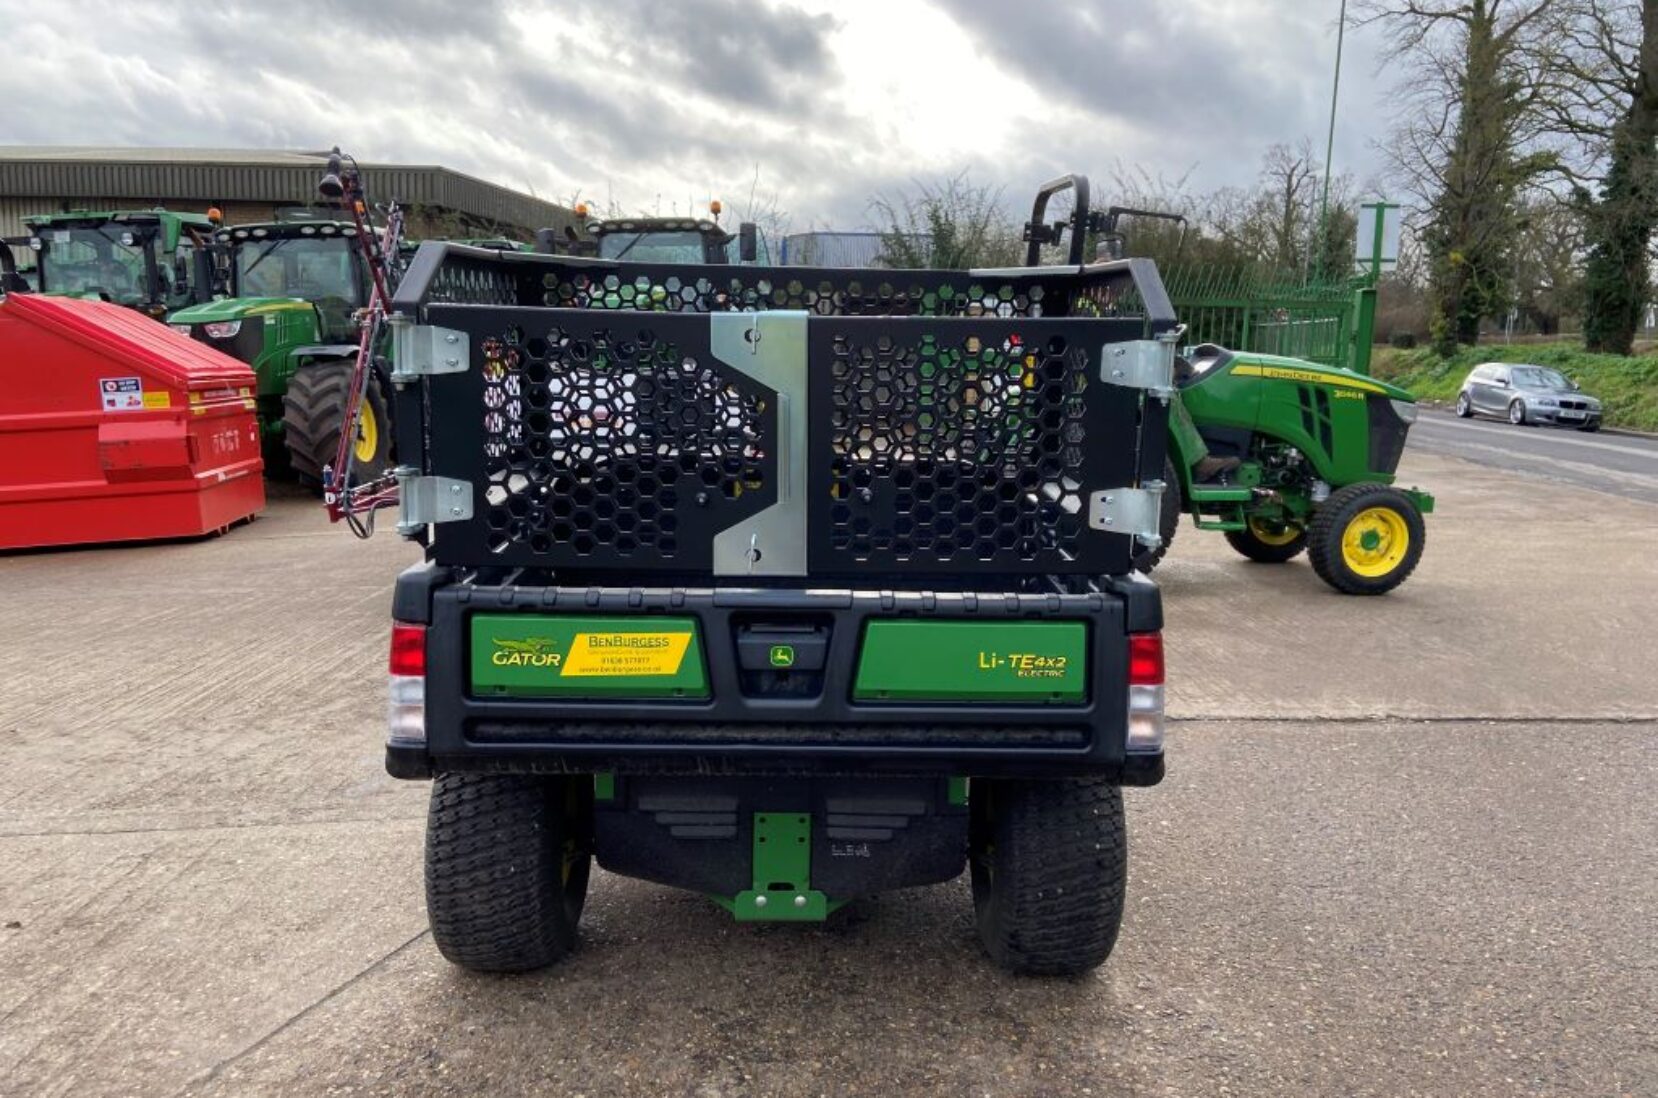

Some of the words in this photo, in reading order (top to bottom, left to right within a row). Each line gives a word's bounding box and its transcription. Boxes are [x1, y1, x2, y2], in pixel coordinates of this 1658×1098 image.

[492, 651, 561, 667] GATOR
[979, 651, 1005, 669] Li-
[1018, 670, 1065, 678] ELECTRIC
